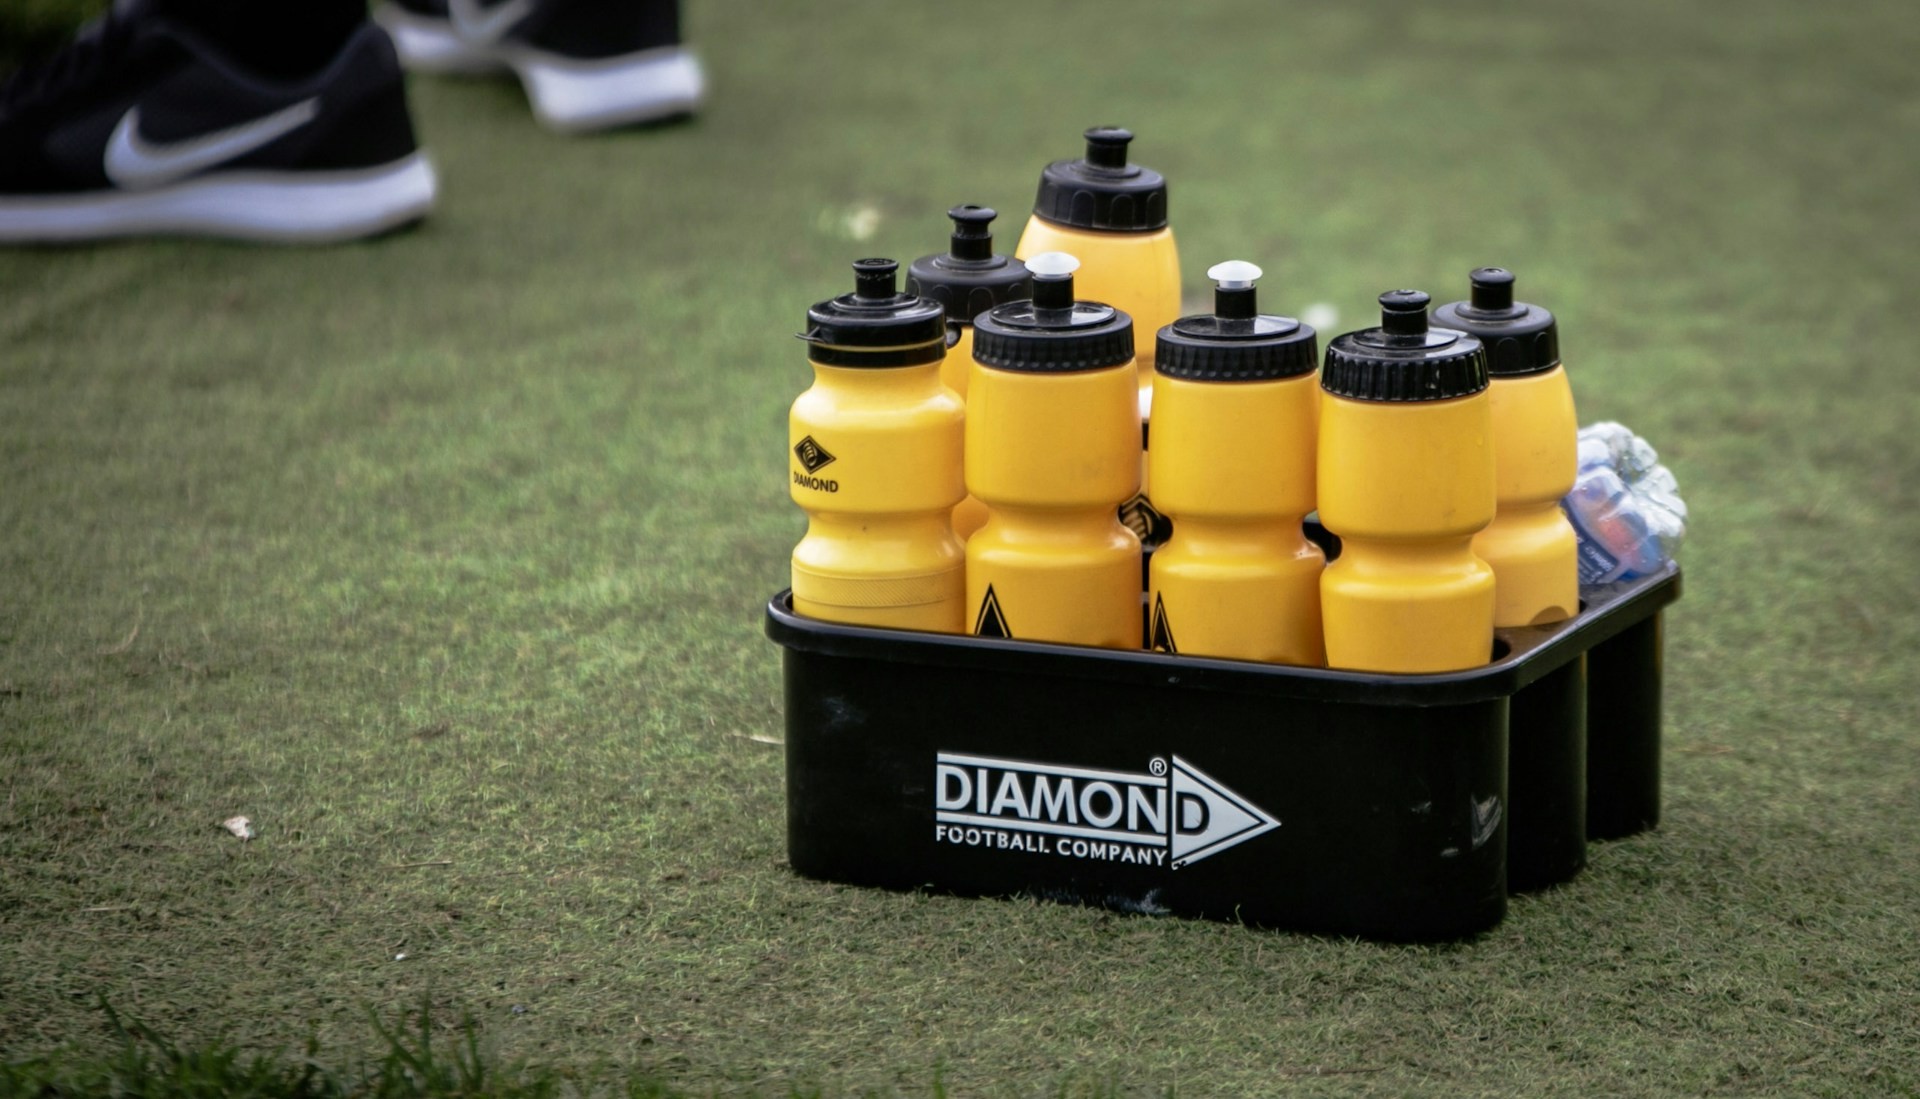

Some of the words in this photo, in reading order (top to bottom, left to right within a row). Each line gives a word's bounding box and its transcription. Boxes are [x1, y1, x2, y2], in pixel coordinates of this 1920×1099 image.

[794, 471, 839, 493] DIAMOND
[936, 764, 1210, 835] DIAMOND
[936, 825, 1051, 854] FOOTBALL
[1056, 839, 1168, 867] COMPANY
